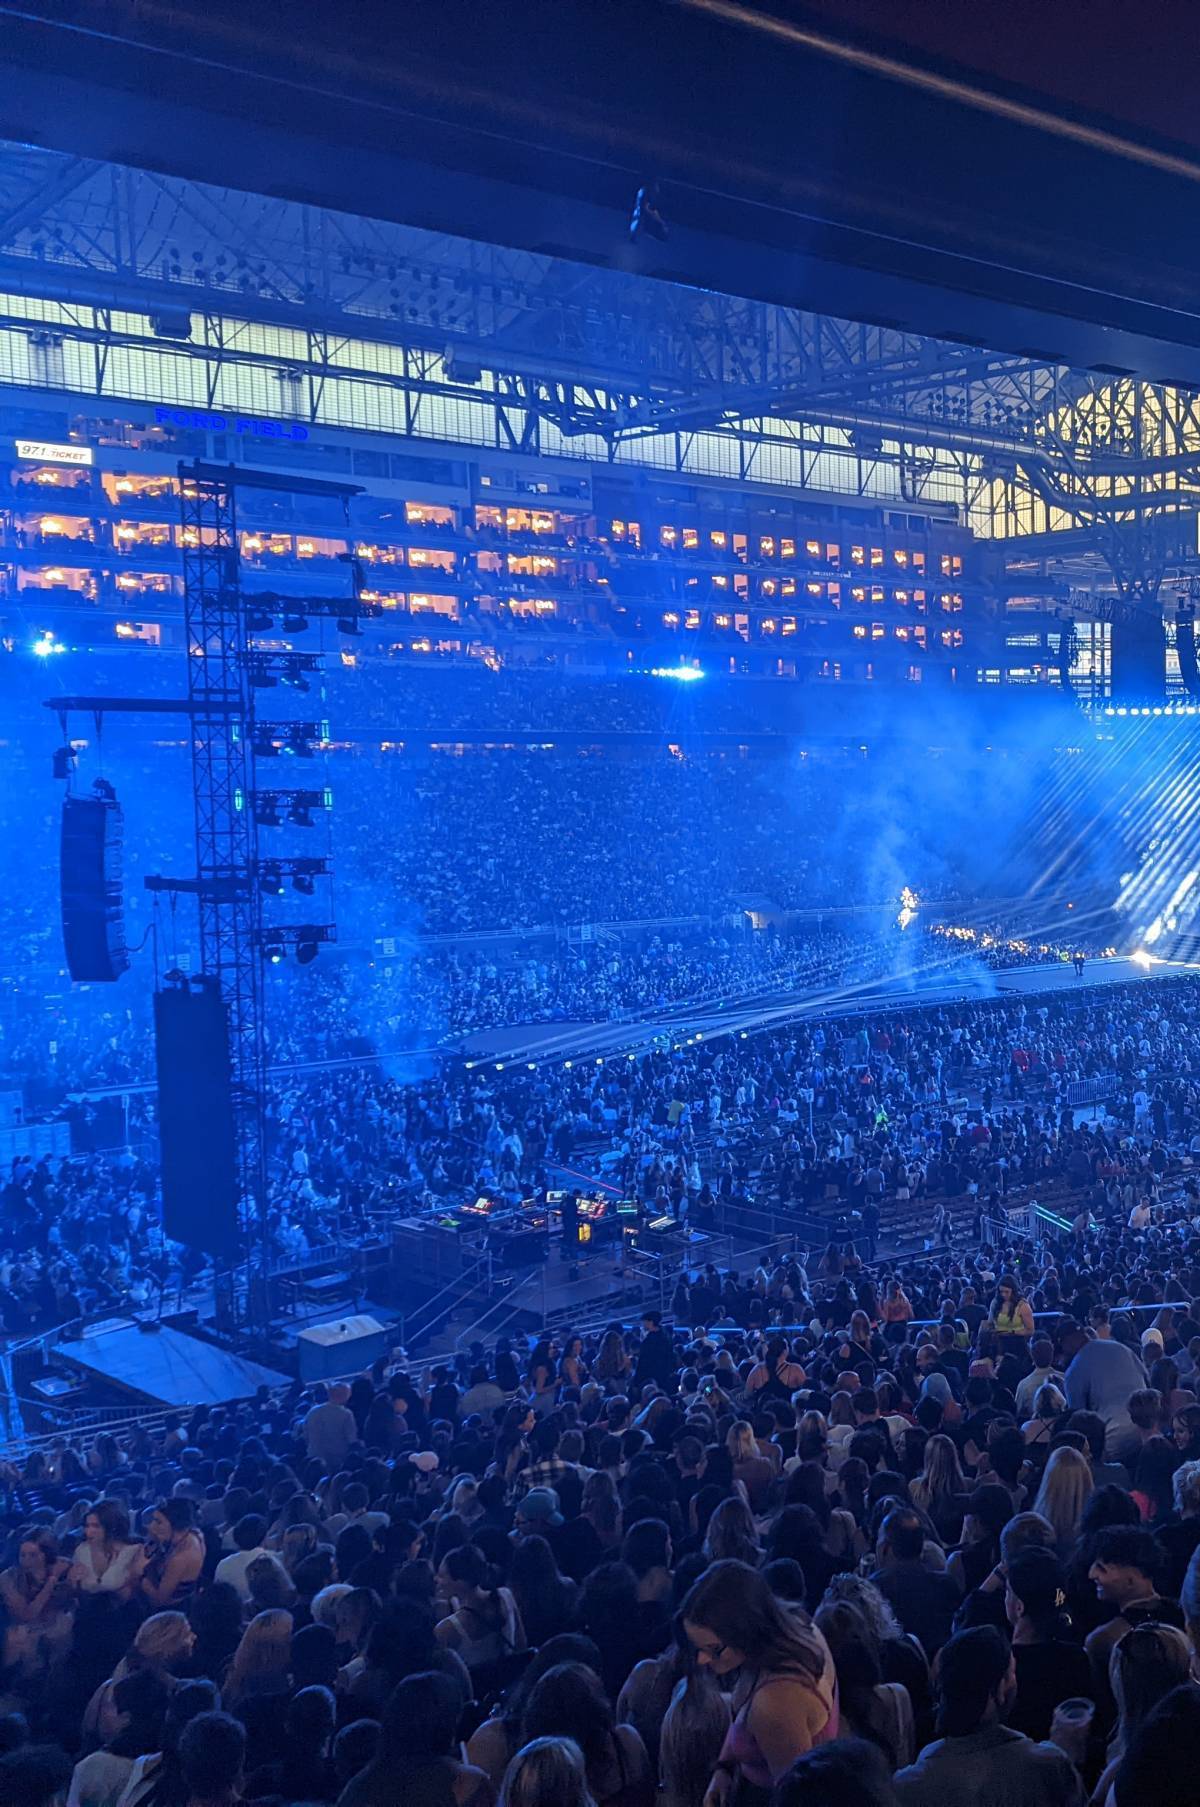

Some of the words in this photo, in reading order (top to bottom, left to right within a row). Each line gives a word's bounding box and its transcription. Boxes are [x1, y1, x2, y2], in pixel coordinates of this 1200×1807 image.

[155, 408, 226, 431] FORD
[236, 419, 308, 441] FIELD
[50, 450, 86, 460] TICKET
